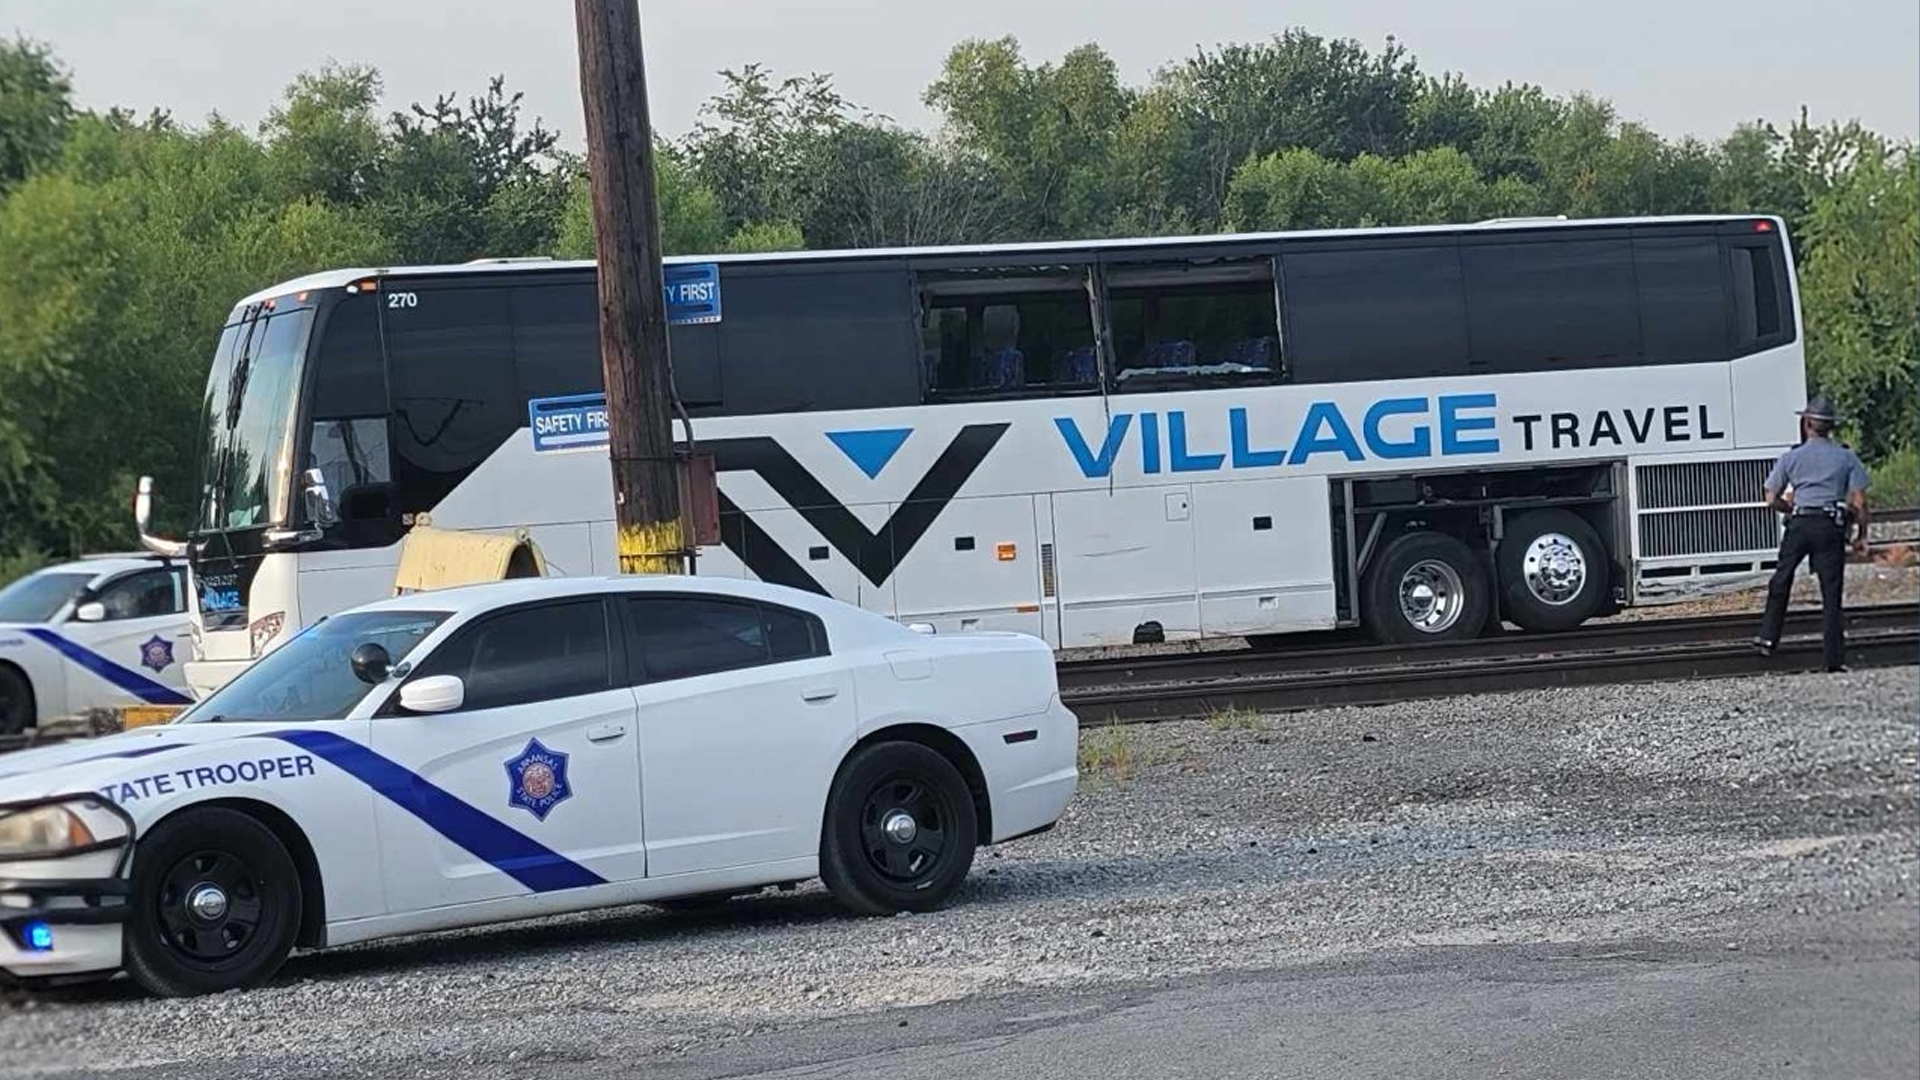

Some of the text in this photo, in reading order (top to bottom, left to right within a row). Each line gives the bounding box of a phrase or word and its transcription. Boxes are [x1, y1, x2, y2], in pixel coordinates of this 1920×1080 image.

[388, 292, 417, 308] 270
[680, 282, 714, 302] FIRST
[535, 410, 609, 434] SAFETY FIRS
[1054, 394, 1724, 478] VILLAGE TRAVEL
[176, 755, 315, 789] TROOPER
